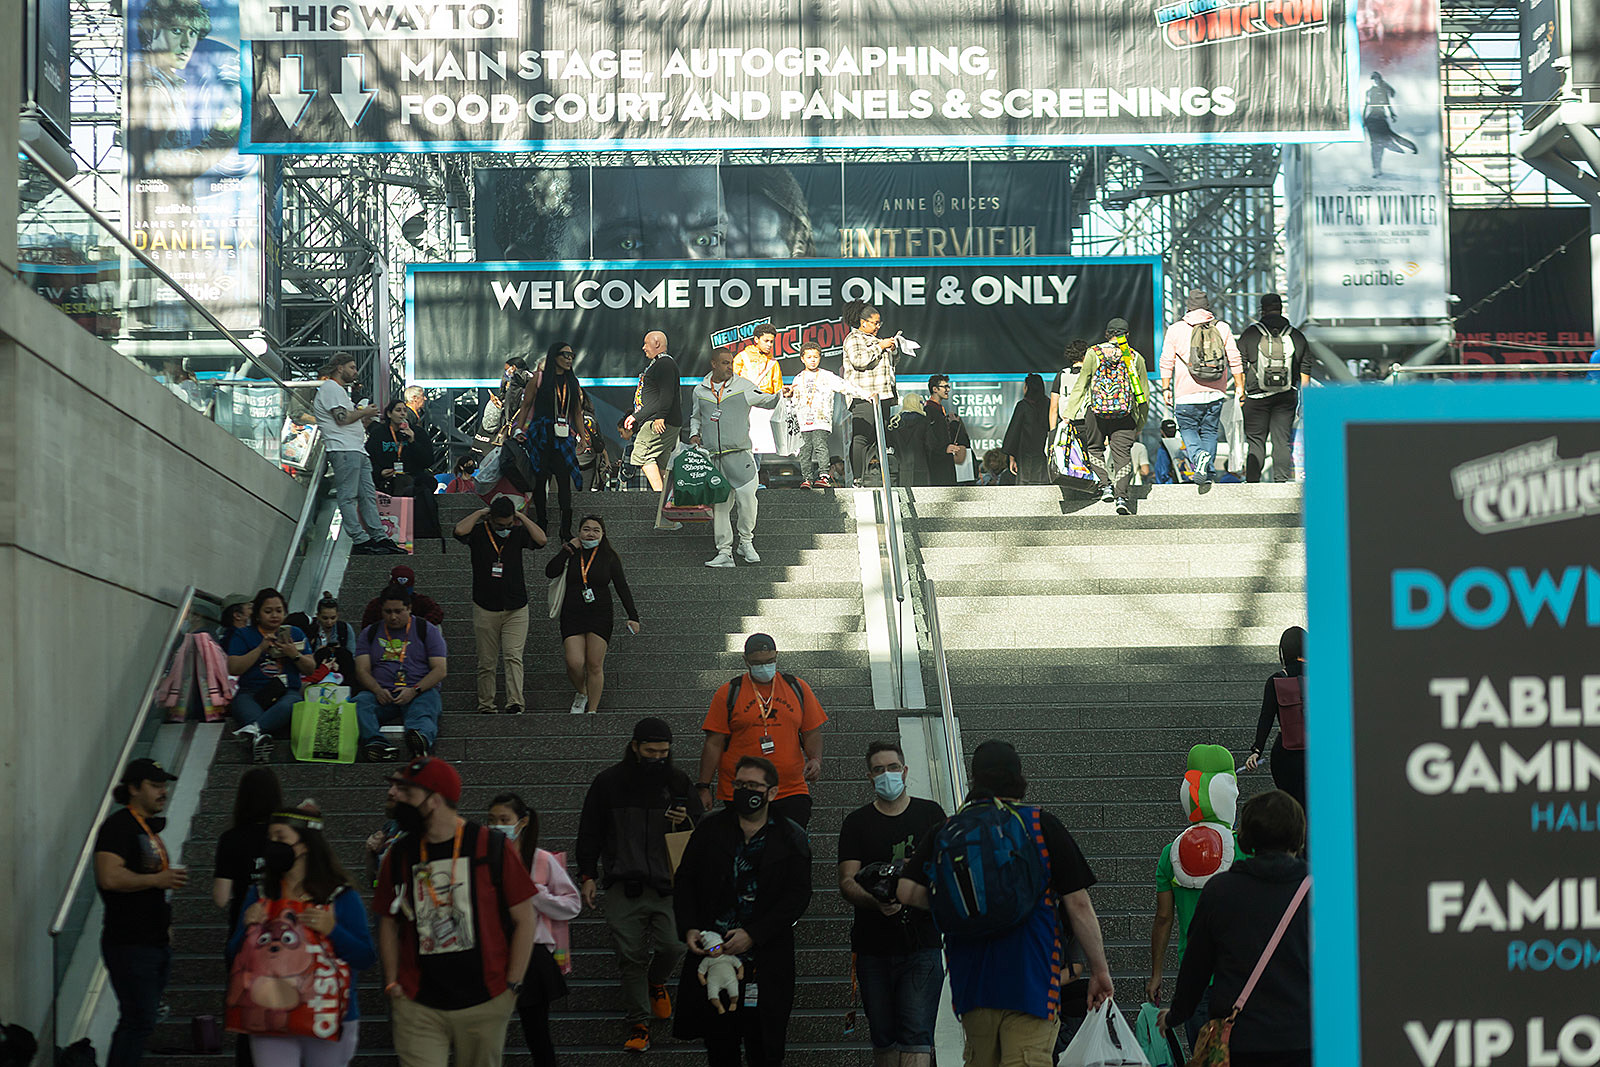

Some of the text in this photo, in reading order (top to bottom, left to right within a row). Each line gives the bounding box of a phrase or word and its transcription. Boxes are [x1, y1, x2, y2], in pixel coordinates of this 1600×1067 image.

[269, 4, 504, 32] THIS WAY TO:
[1168, 0, 1323, 46] COMIC CON
[400, 45, 998, 84] MAIN STAGE, AUTOGRAPHING,
[400, 86, 1237, 127] FOOD COURT, AND PANELS & SCREENINGS
[882, 197, 1000, 211] ANNE RICE'S
[1315, 194, 1437, 225] IMPACT WINTER
[134, 220, 176, 229] JAMES
[132, 228, 256, 251] DANIEL X
[151, 250, 237, 259] GENESIS
[1342, 270, 1405, 286] audible
[491, 275, 1077, 311] WELCOME TO THE ONE & ONLY
[713, 328, 738, 346] NEW
[1456, 332, 1492, 346] ONE
[1496, 331, 1548, 345] PIECE
[952, 394, 1003, 405] STREAM
[957, 406, 997, 417] EARLY
[970, 439, 1003, 450] IVERS
[1531, 801, 1600, 832] HAL
[1403, 1018, 1515, 1067] VIP
